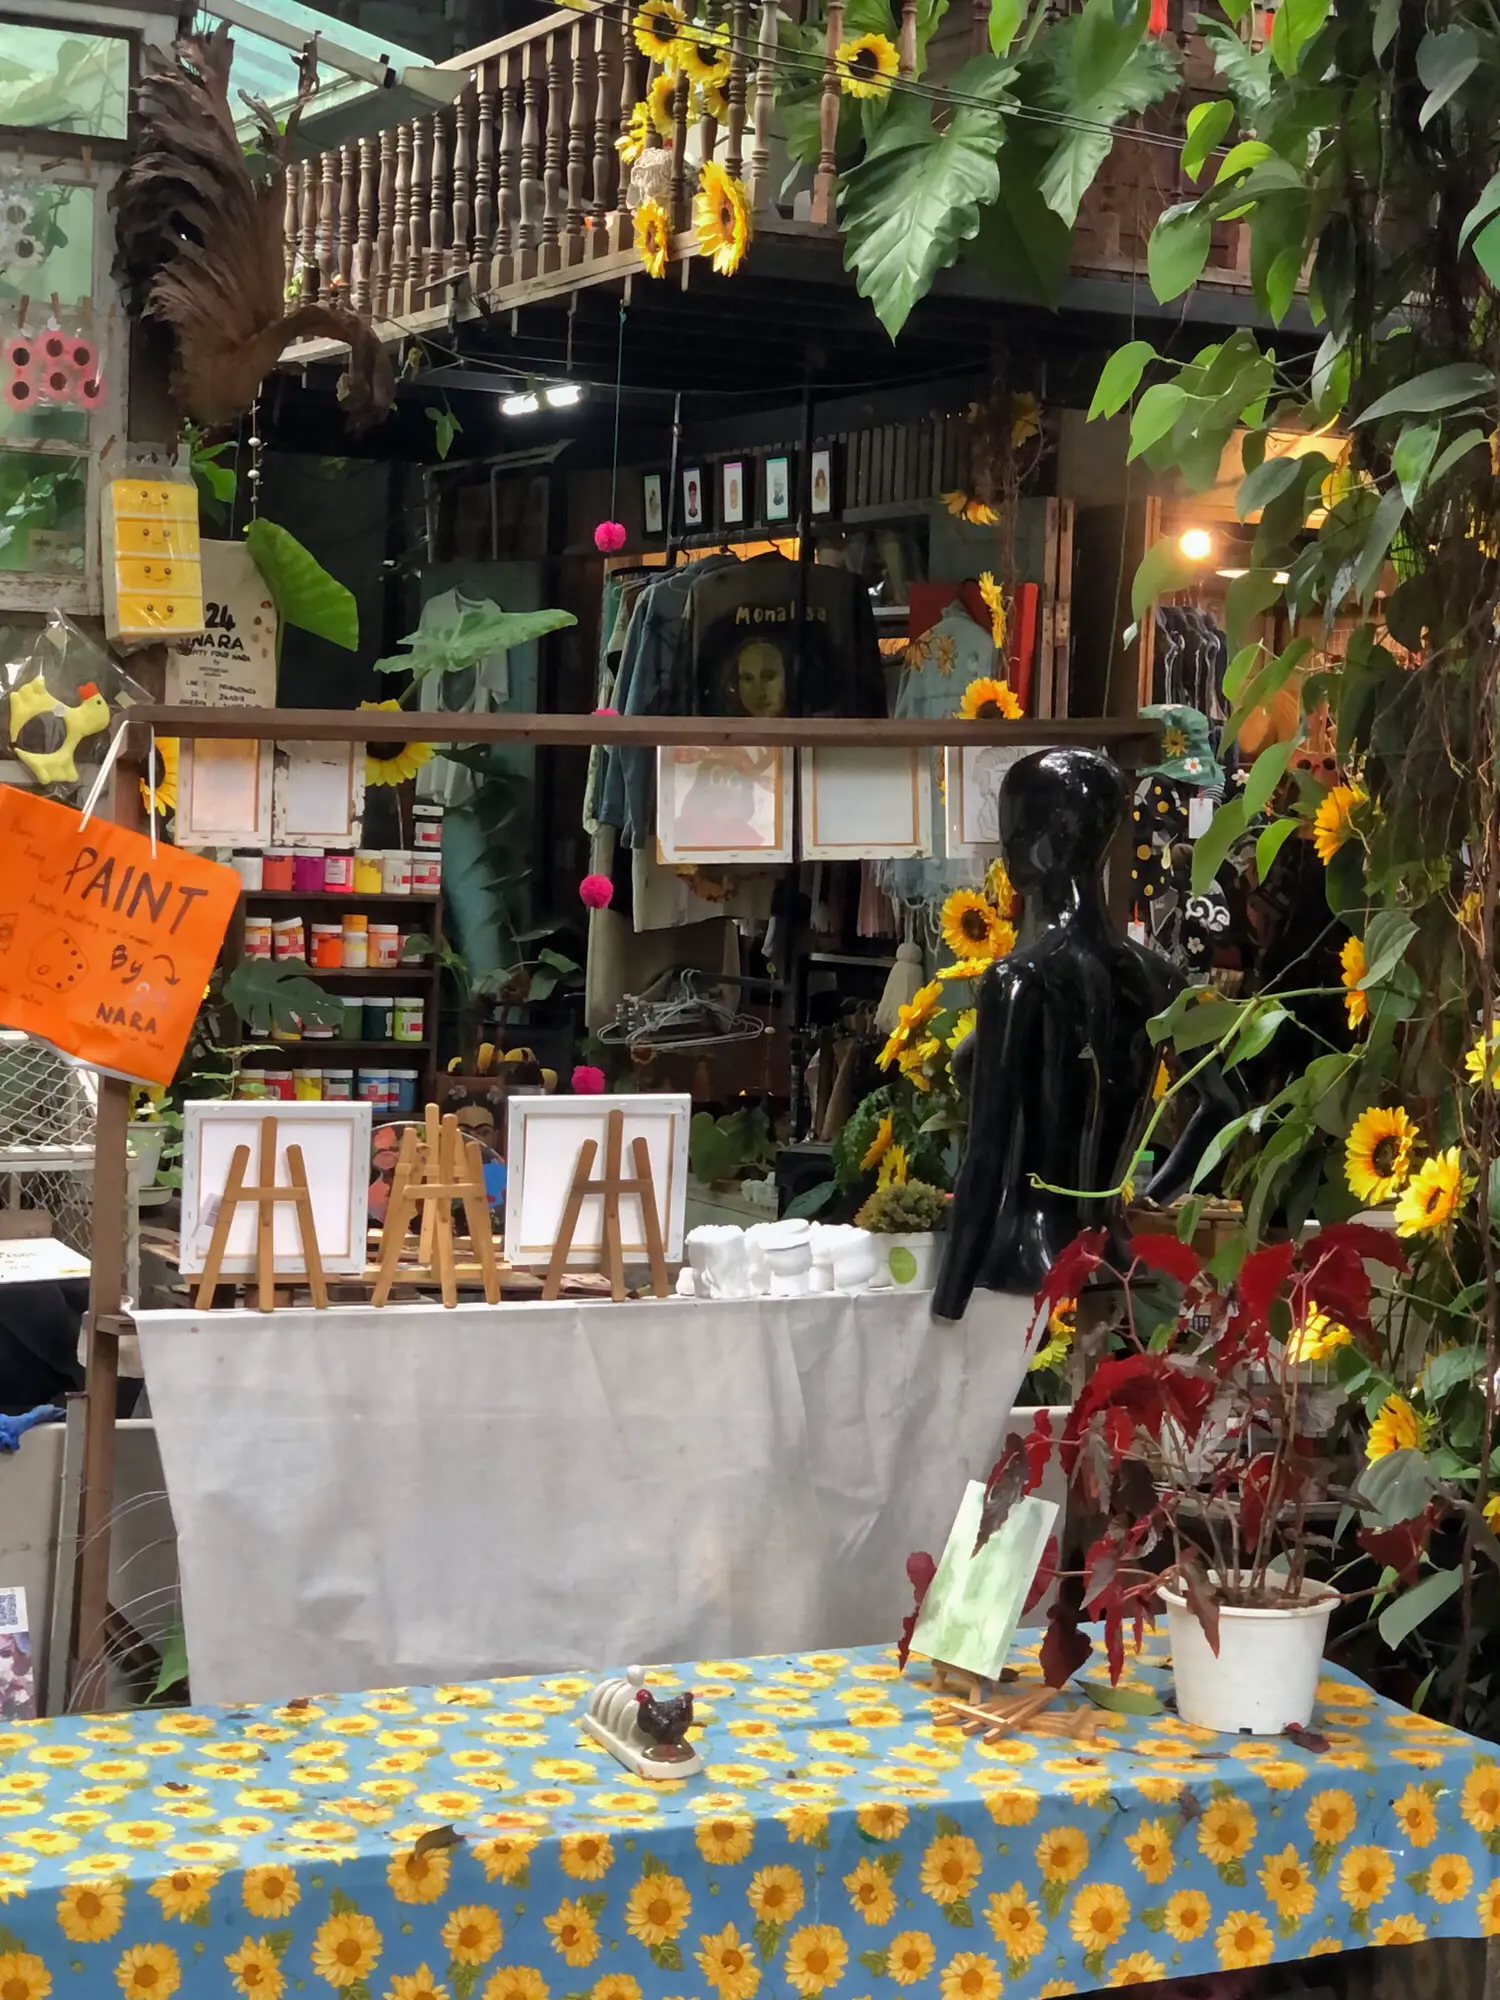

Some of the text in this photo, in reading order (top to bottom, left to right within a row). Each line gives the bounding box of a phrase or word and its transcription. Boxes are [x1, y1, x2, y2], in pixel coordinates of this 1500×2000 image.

[205, 602, 236, 632] 24
[735, 600, 827, 625] Monalsa
[191, 633, 244, 651] NARA
[63, 846, 208, 935] PAINT
[110, 944, 144, 985] By
[96, 1002, 157, 1035] NARA
